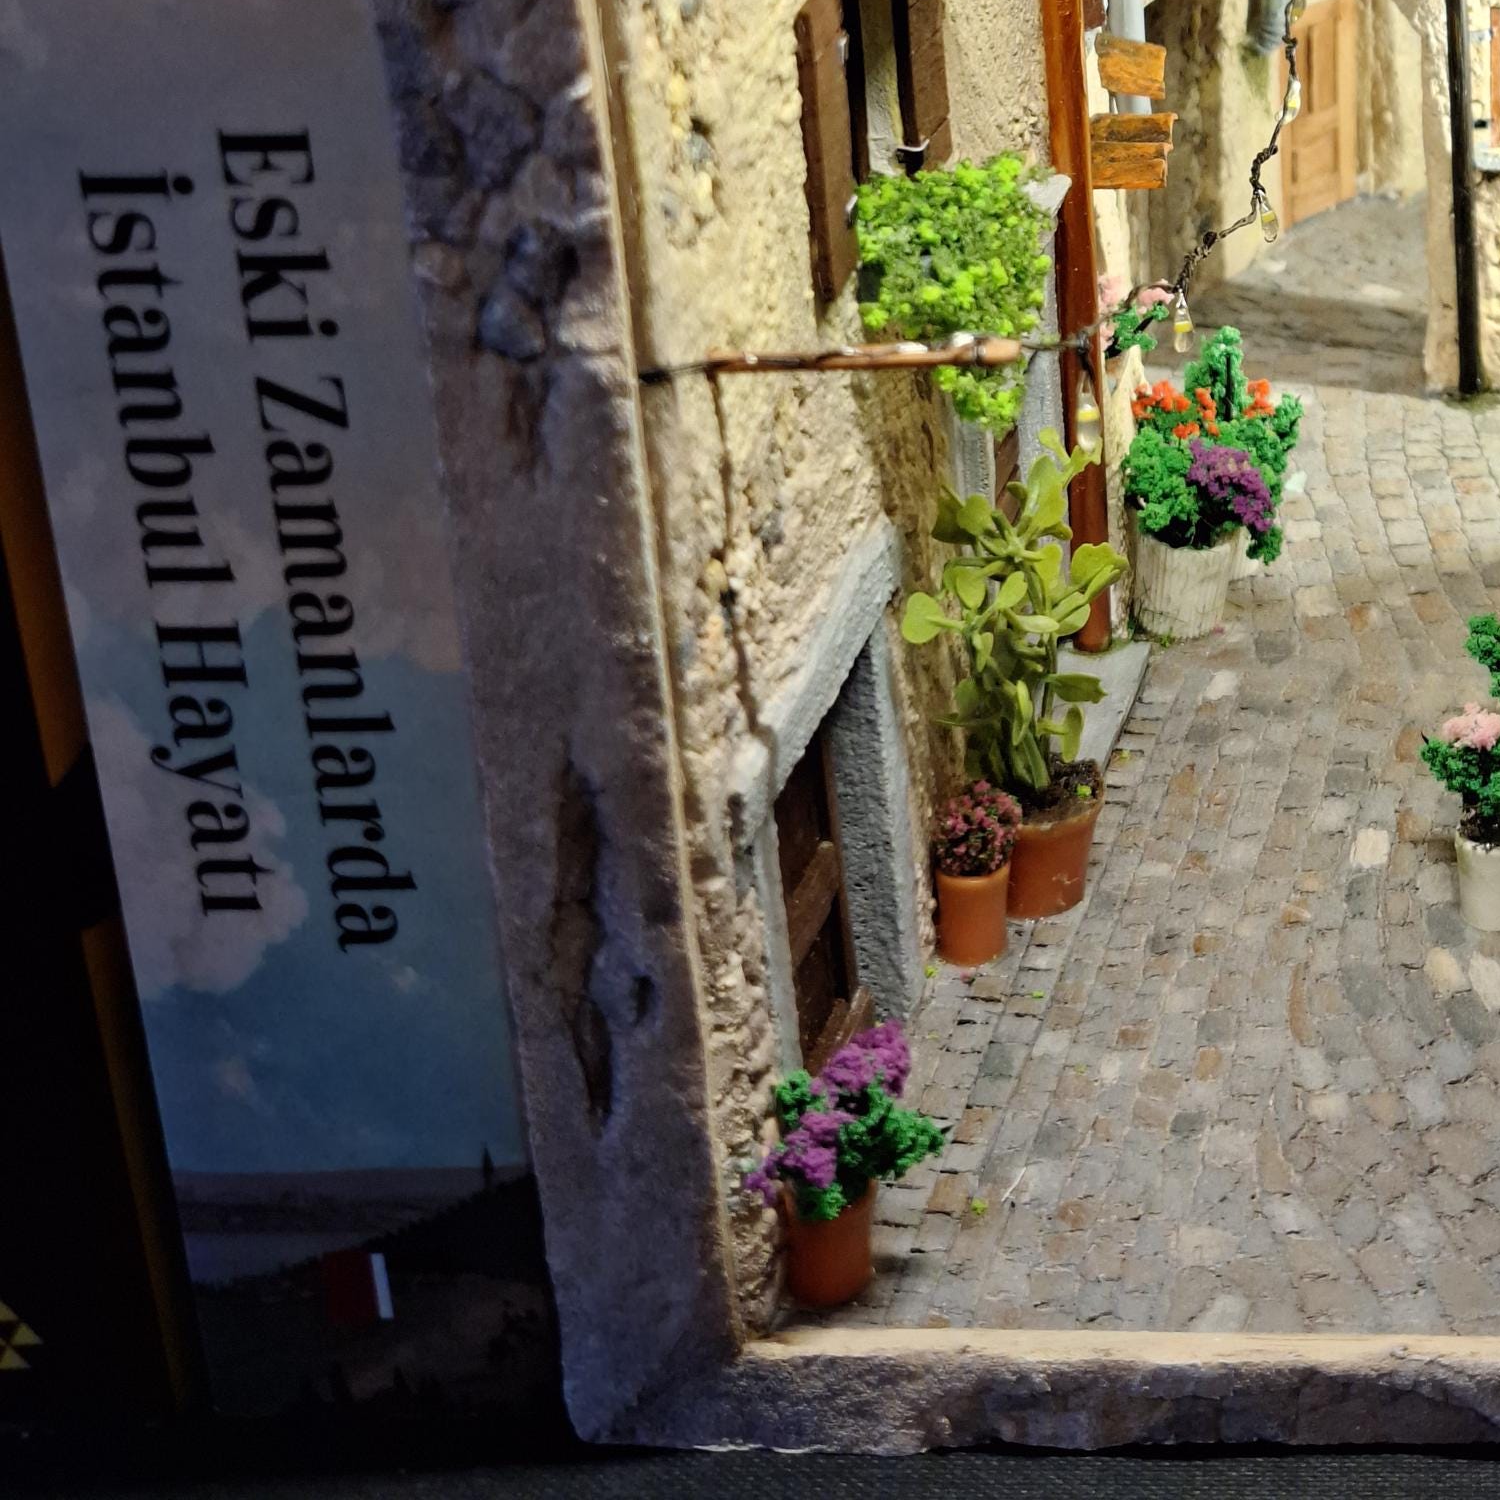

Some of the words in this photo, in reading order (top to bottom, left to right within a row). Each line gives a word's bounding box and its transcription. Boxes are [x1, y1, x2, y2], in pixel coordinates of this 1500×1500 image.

[78, 167, 236, 588] İstanbul
[216, 128, 340, 343] Eski
[149, 620, 274, 917] Hayatı
[254, 375, 418, 953] Zamanlarda
